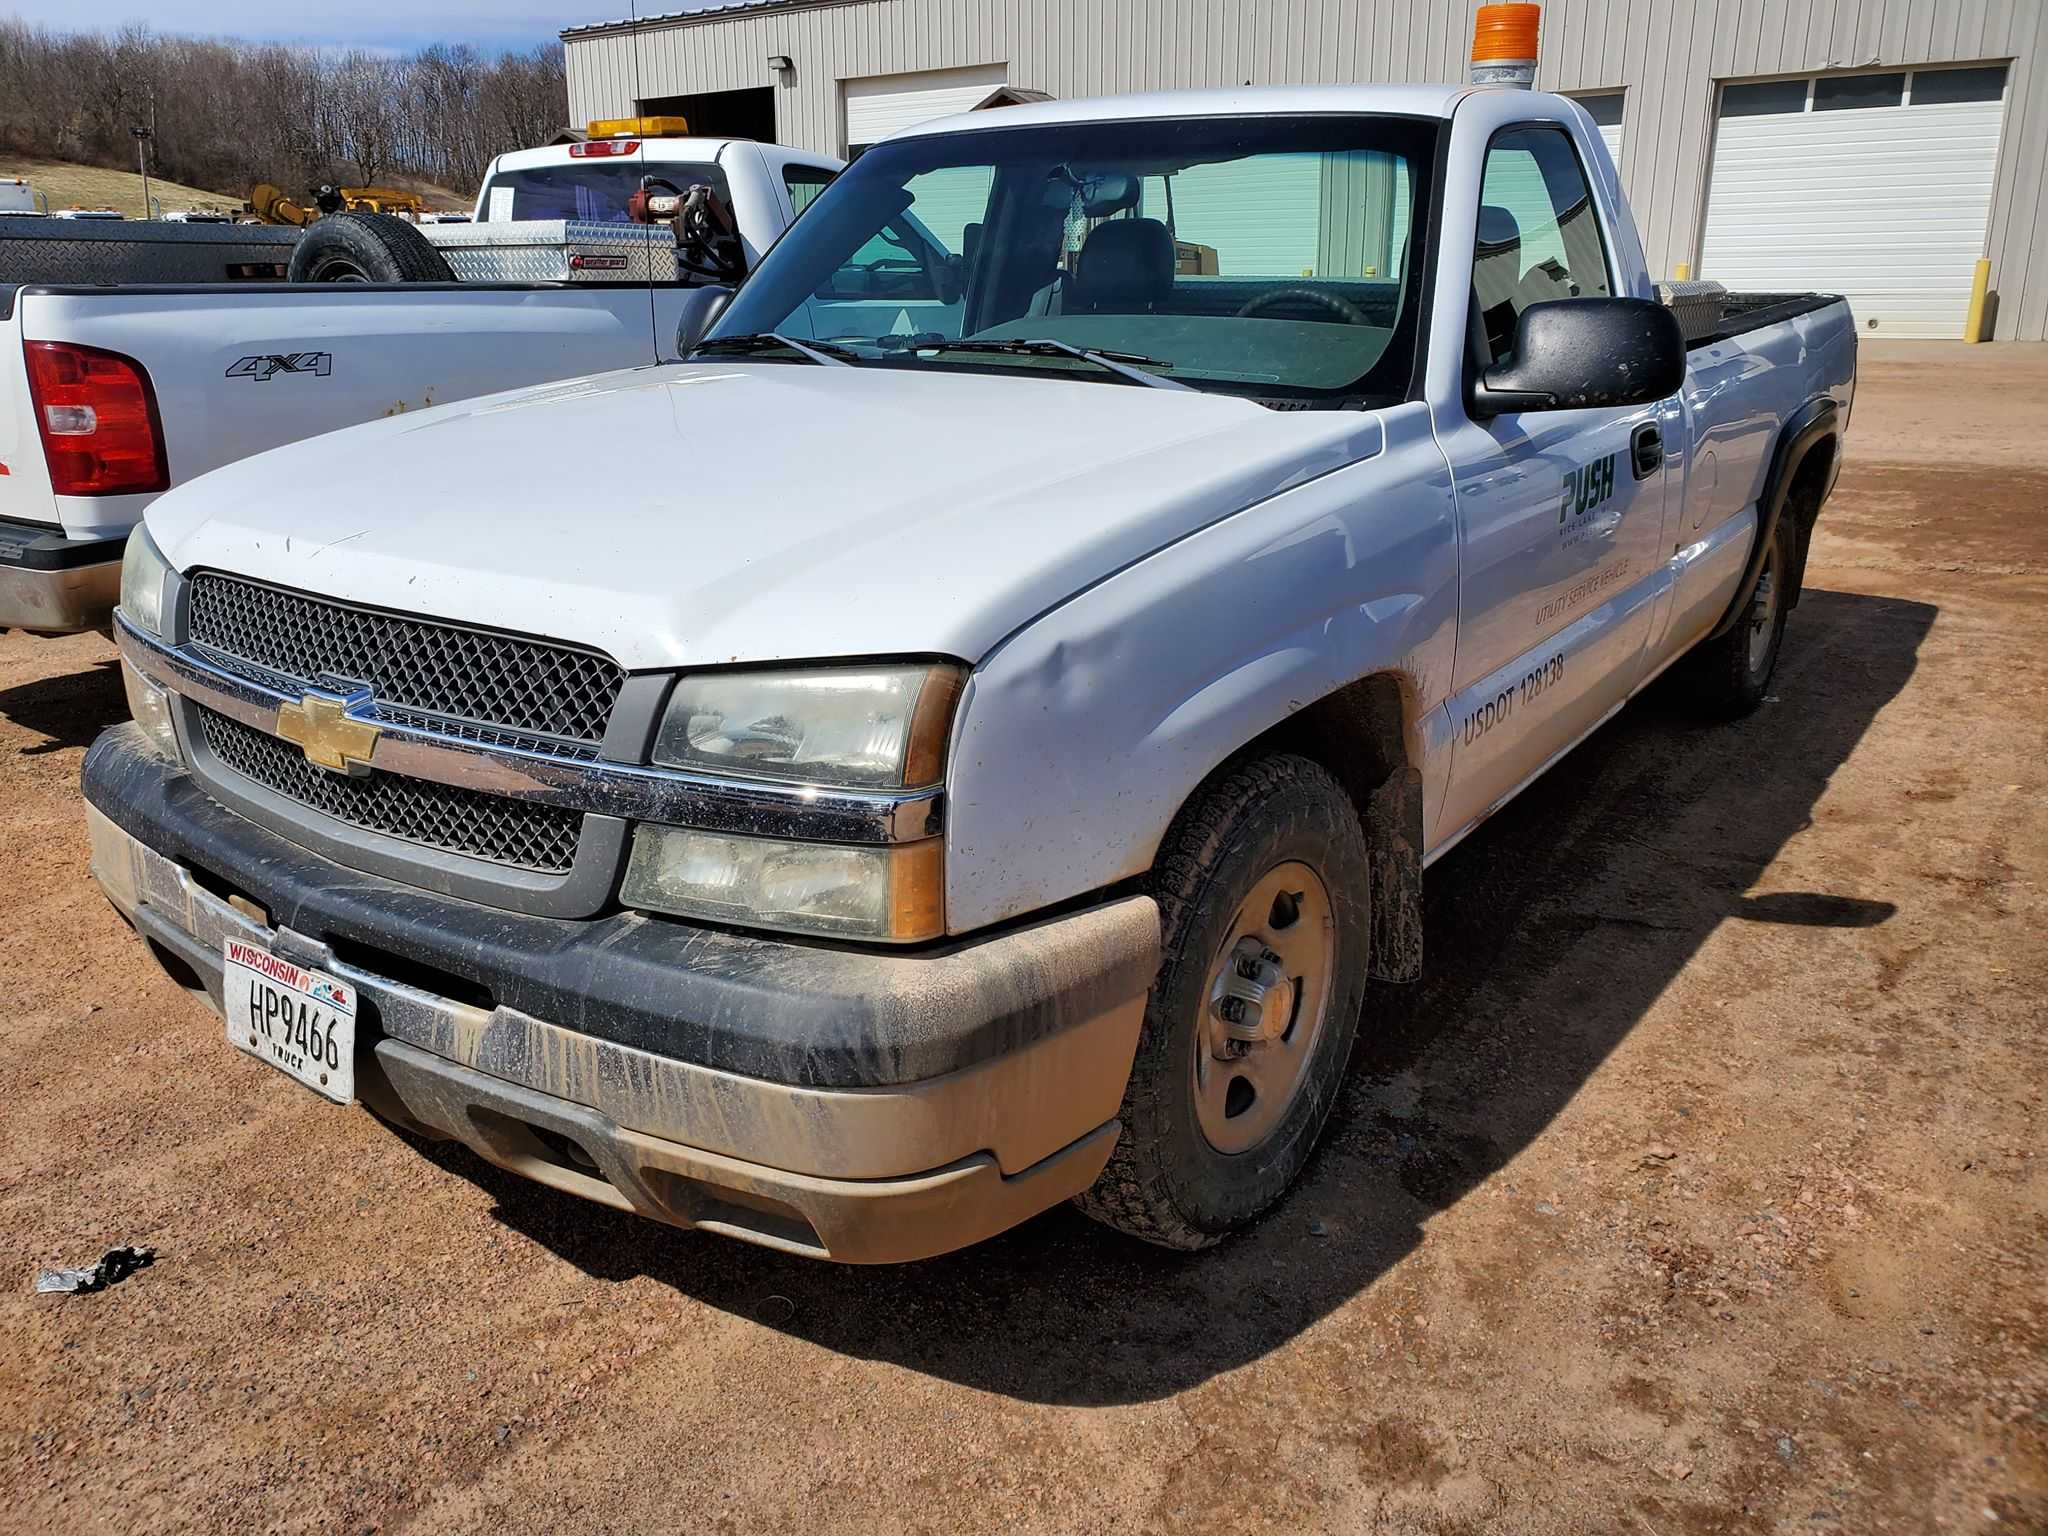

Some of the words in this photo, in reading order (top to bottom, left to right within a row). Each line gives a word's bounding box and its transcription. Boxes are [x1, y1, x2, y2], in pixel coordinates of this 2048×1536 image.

[1560, 453, 1615, 524] PUSH
[1464, 686, 1515, 747] USDOT
[1520, 653, 1564, 706] 128138
[229, 943, 300, 987] WISCONSIN
[250, 979, 339, 1071] HP9466
[272, 1042, 304, 1073] TRUCK
